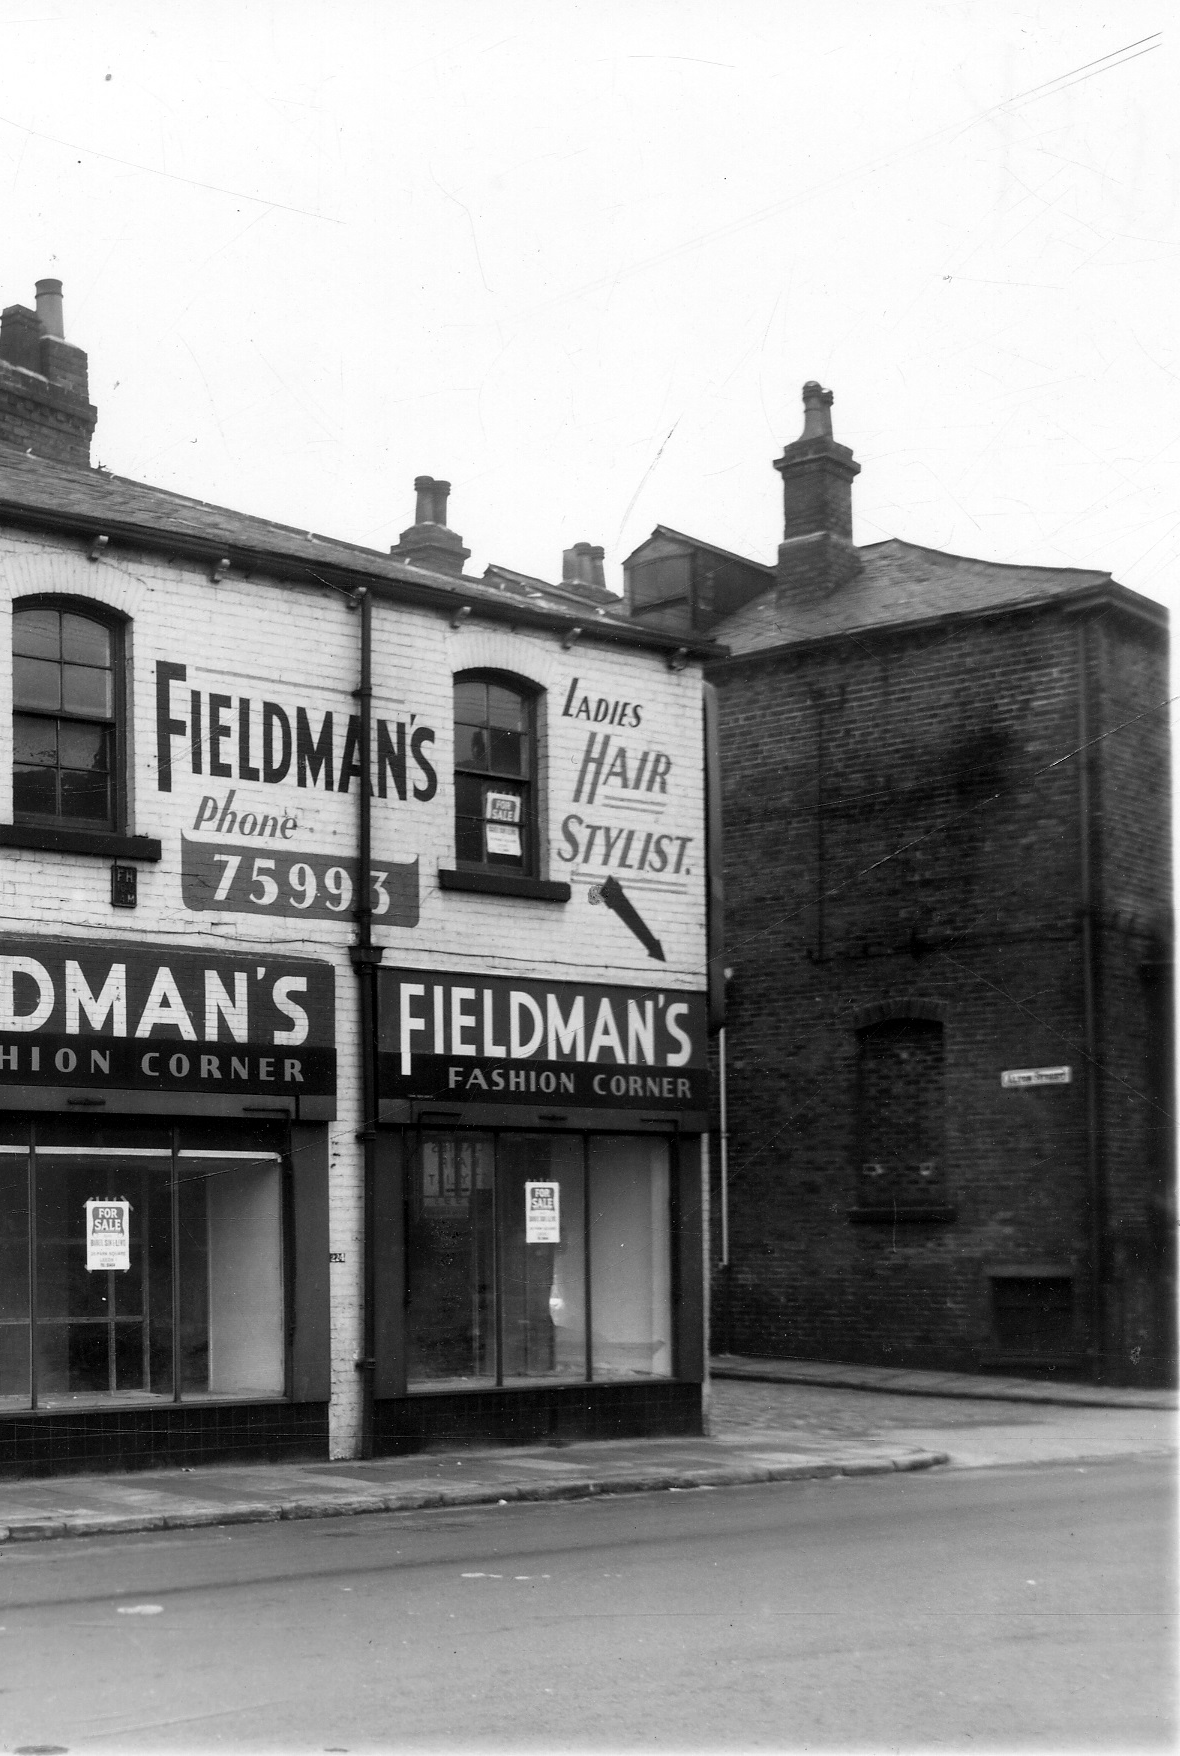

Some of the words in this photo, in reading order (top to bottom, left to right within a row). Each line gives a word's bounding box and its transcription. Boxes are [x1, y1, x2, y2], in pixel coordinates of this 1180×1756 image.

[561, 678, 643, 729] LADIES
[156, 660, 439, 802] FIELDMAN'S
[573, 731, 672, 804] HAIR
[193, 790, 298, 839] Phone
[212, 854, 390, 914] 75993
[399, 982, 692, 1075] FIELDMAN'S
[140, 1051, 305, 1082] CORNER
[448, 1066, 575, 1094] FASHION
[592, 1074, 692, 1099] CORNER
[94, 1219, 122, 1231] SALE
[98, 1208, 118, 1218] FOR
[532, 1198, 554, 1208] SALE
